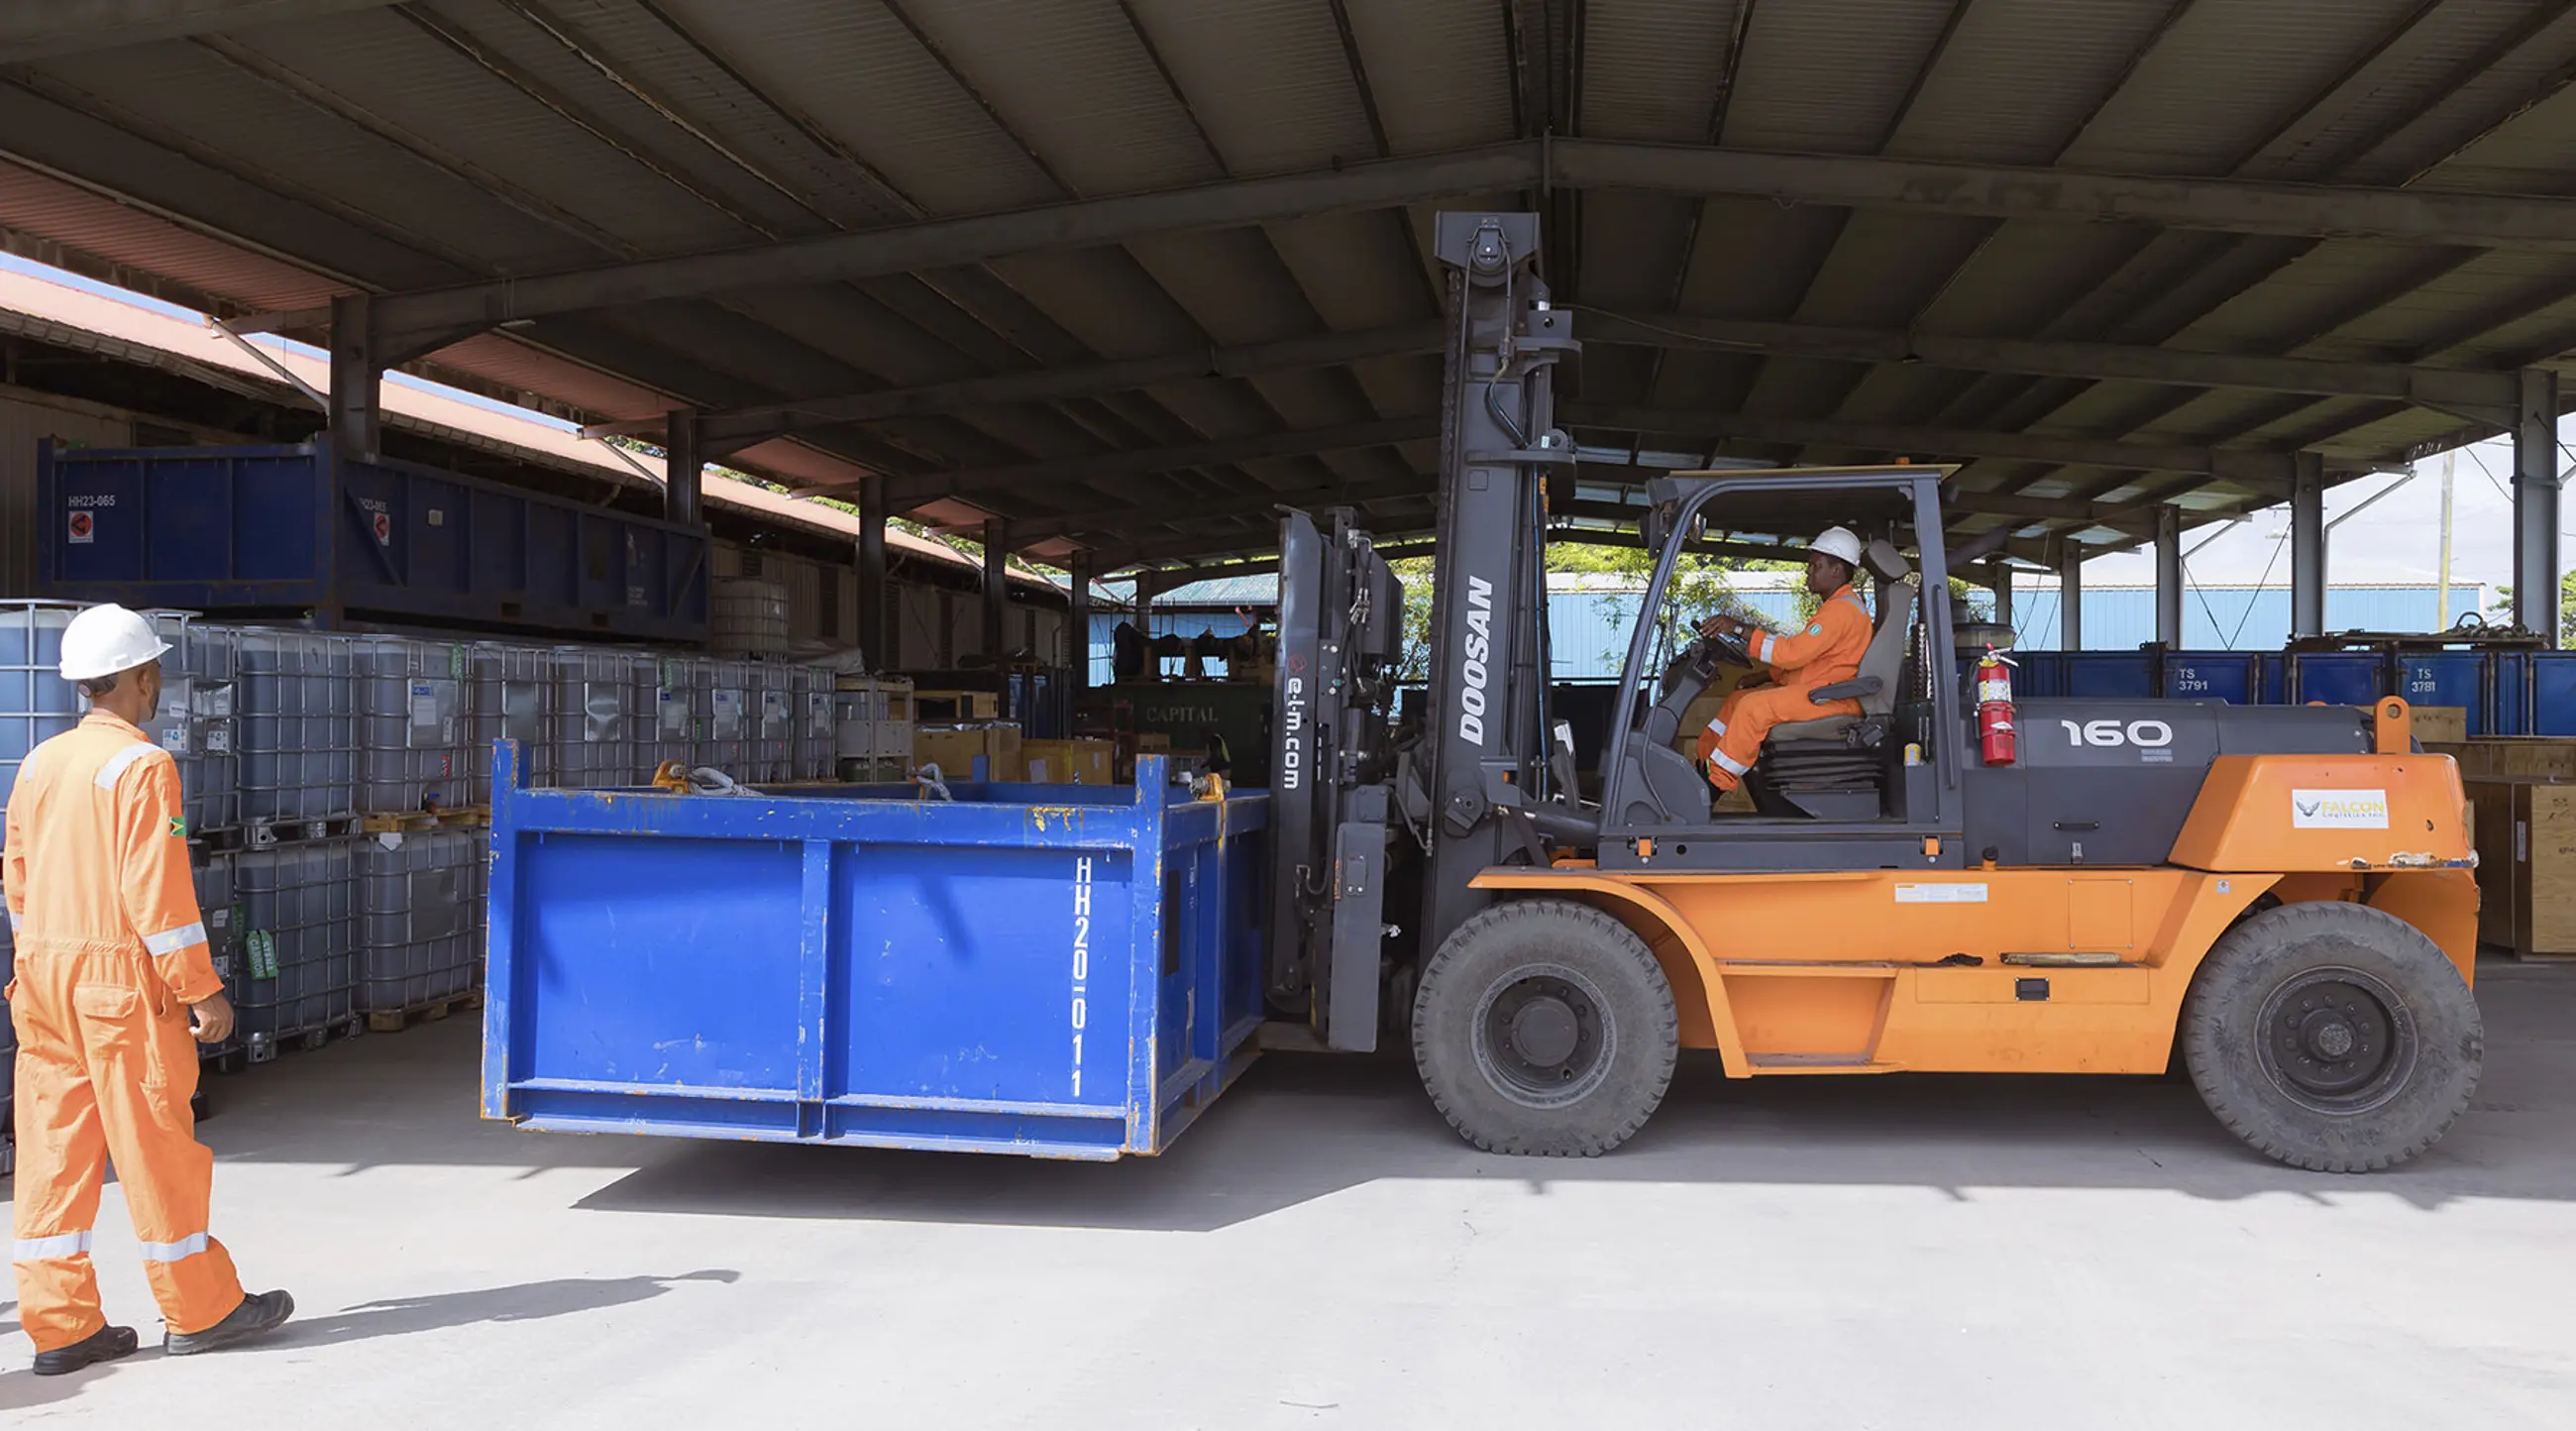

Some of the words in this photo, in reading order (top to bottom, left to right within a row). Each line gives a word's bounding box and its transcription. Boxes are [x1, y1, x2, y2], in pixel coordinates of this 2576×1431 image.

[68, 495, 116, 506] HH23-065
[1459, 575, 1492, 746] DOOSAN
[2180, 668, 2196, 679] TS
[2417, 668, 2431, 680] TS
[2179, 680, 2208, 691] 3791
[2411, 681, 2435, 693] 3781
[1146, 707, 1219, 722] CAPITAL
[2061, 719, 2173, 746] 160
[2321, 801, 2385, 813] FALCON
[1071, 856, 1092, 1097] HH20-011
